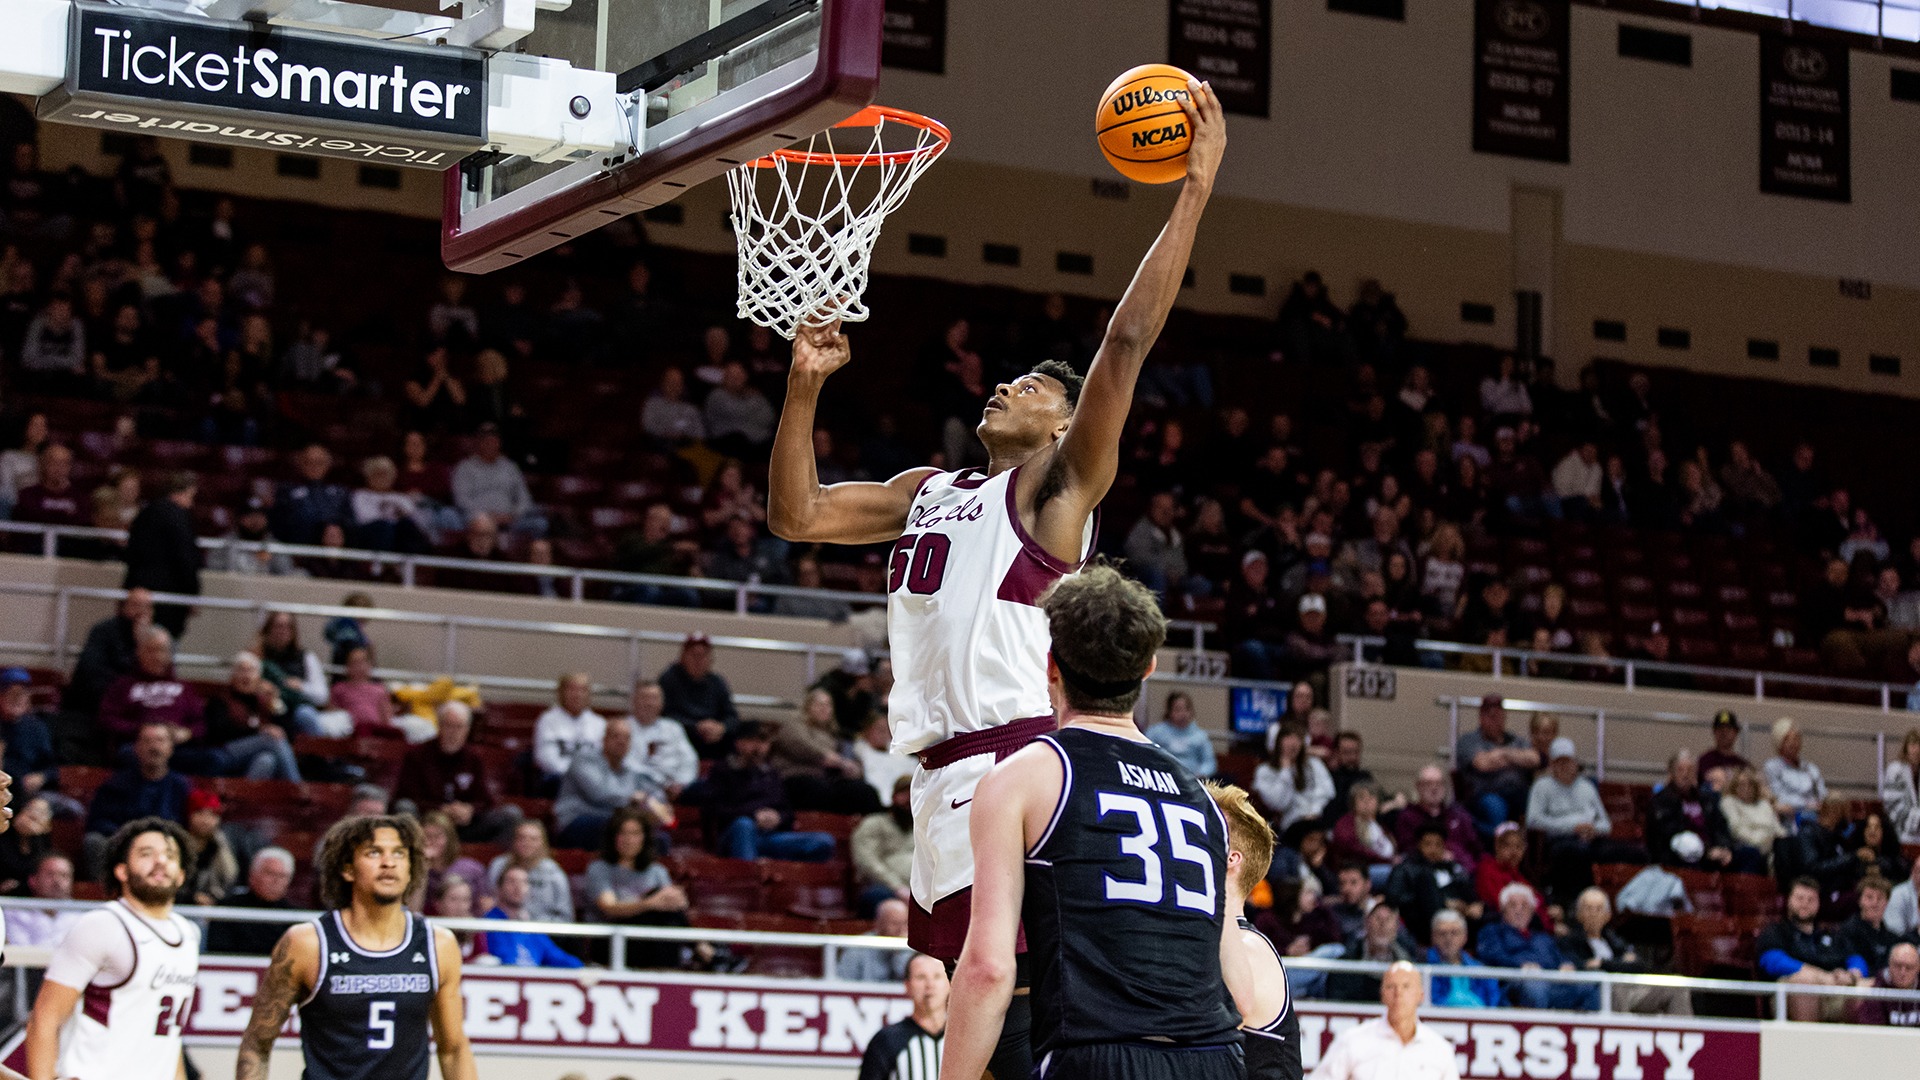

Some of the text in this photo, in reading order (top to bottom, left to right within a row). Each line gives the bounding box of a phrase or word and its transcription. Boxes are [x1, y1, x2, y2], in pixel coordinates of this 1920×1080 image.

[1112, 86, 1191, 116] Wilson
[1131, 122, 1187, 148] NCAA
[888, 532, 952, 595] 50
[1177, 655, 1227, 678] 202
[1347, 669, 1395, 698] 203
[1117, 760, 1181, 796] ASMAN
[1097, 791, 1217, 917] 35
[330, 973, 431, 994] LIPSCOMB
[367, 1001, 396, 1050] 5
